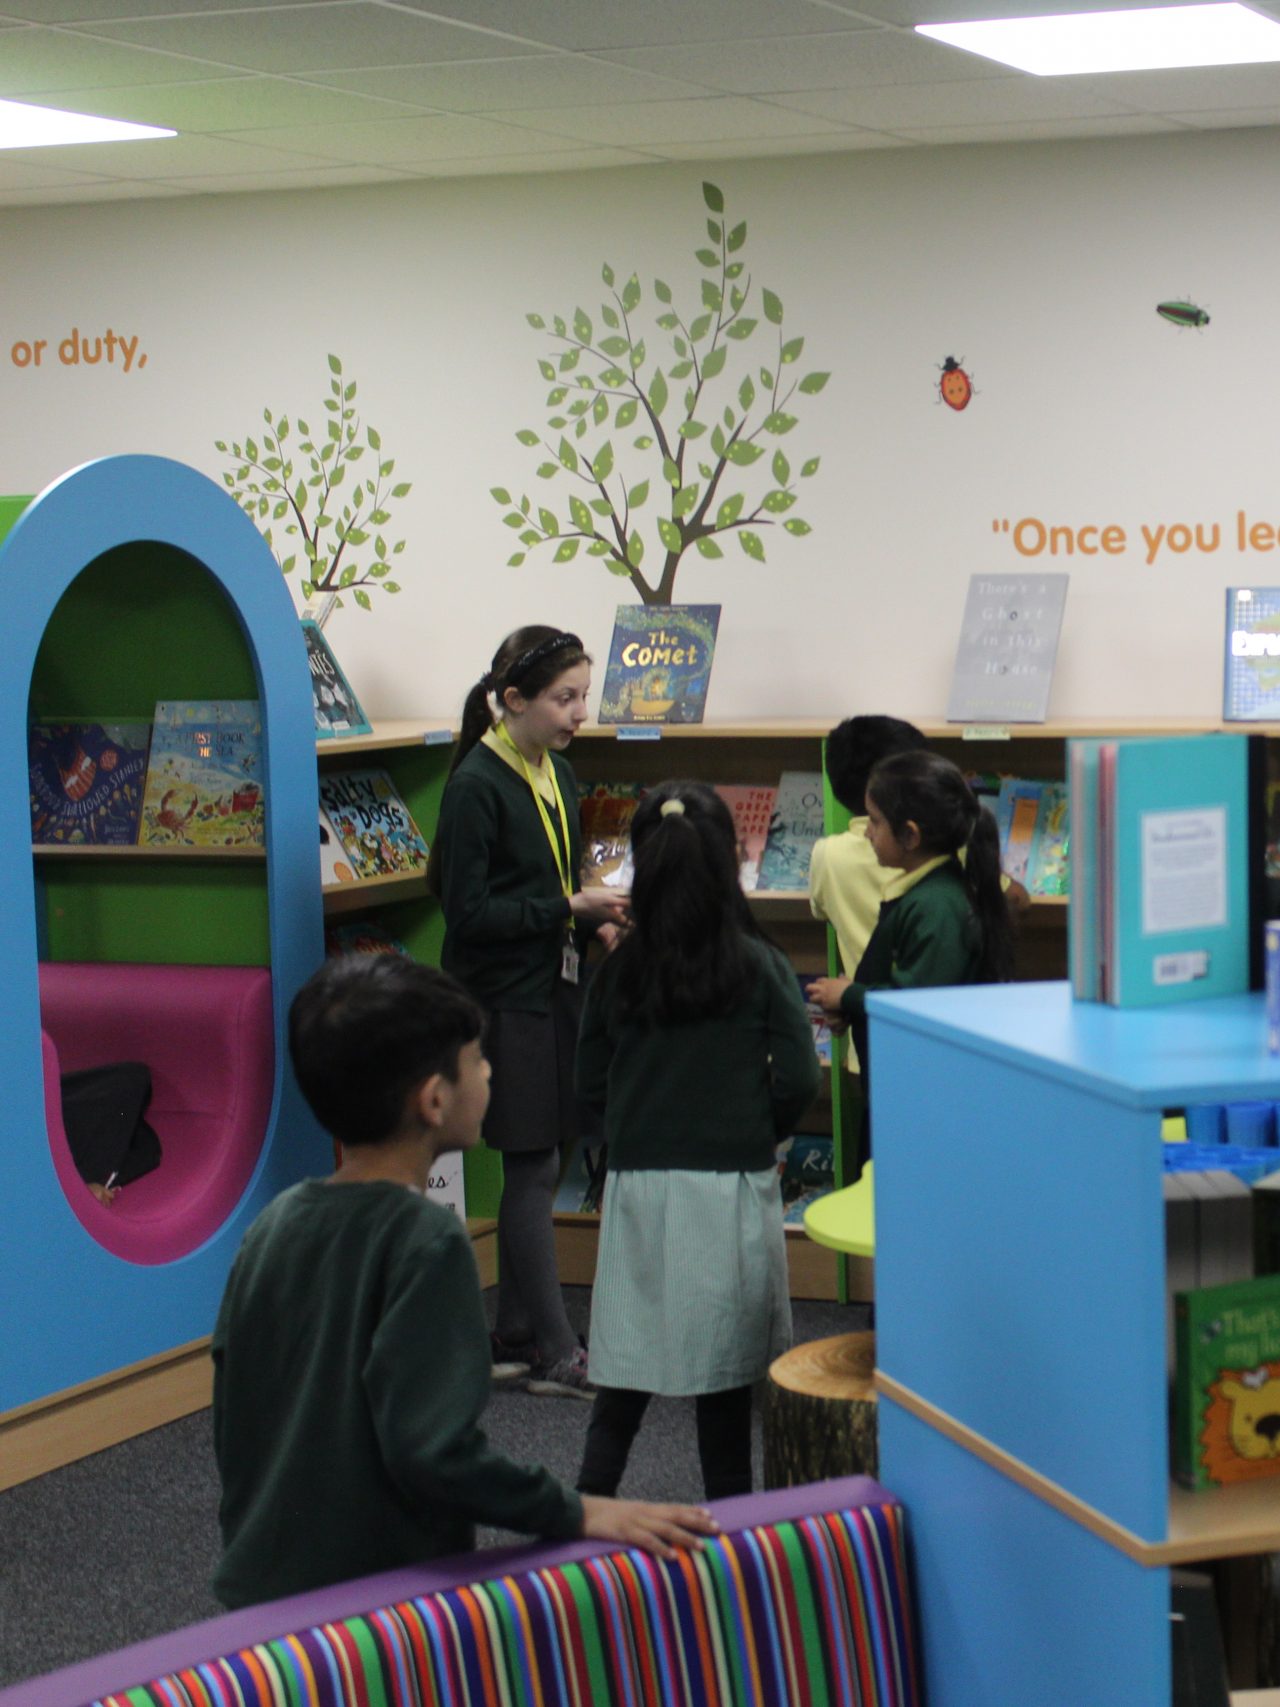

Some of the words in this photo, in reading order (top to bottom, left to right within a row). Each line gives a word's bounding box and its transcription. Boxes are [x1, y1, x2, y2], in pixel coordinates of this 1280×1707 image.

[10, 340, 48, 369] or
[58, 327, 149, 374] duty,
[991, 517, 1127, 558] "Once
[1141, 523, 1221, 565] you
[648, 630, 679, 647] The
[749, 790, 772, 800] THE
[735, 801, 775, 812] GREA
[802, 1150, 834, 1171] Ri
